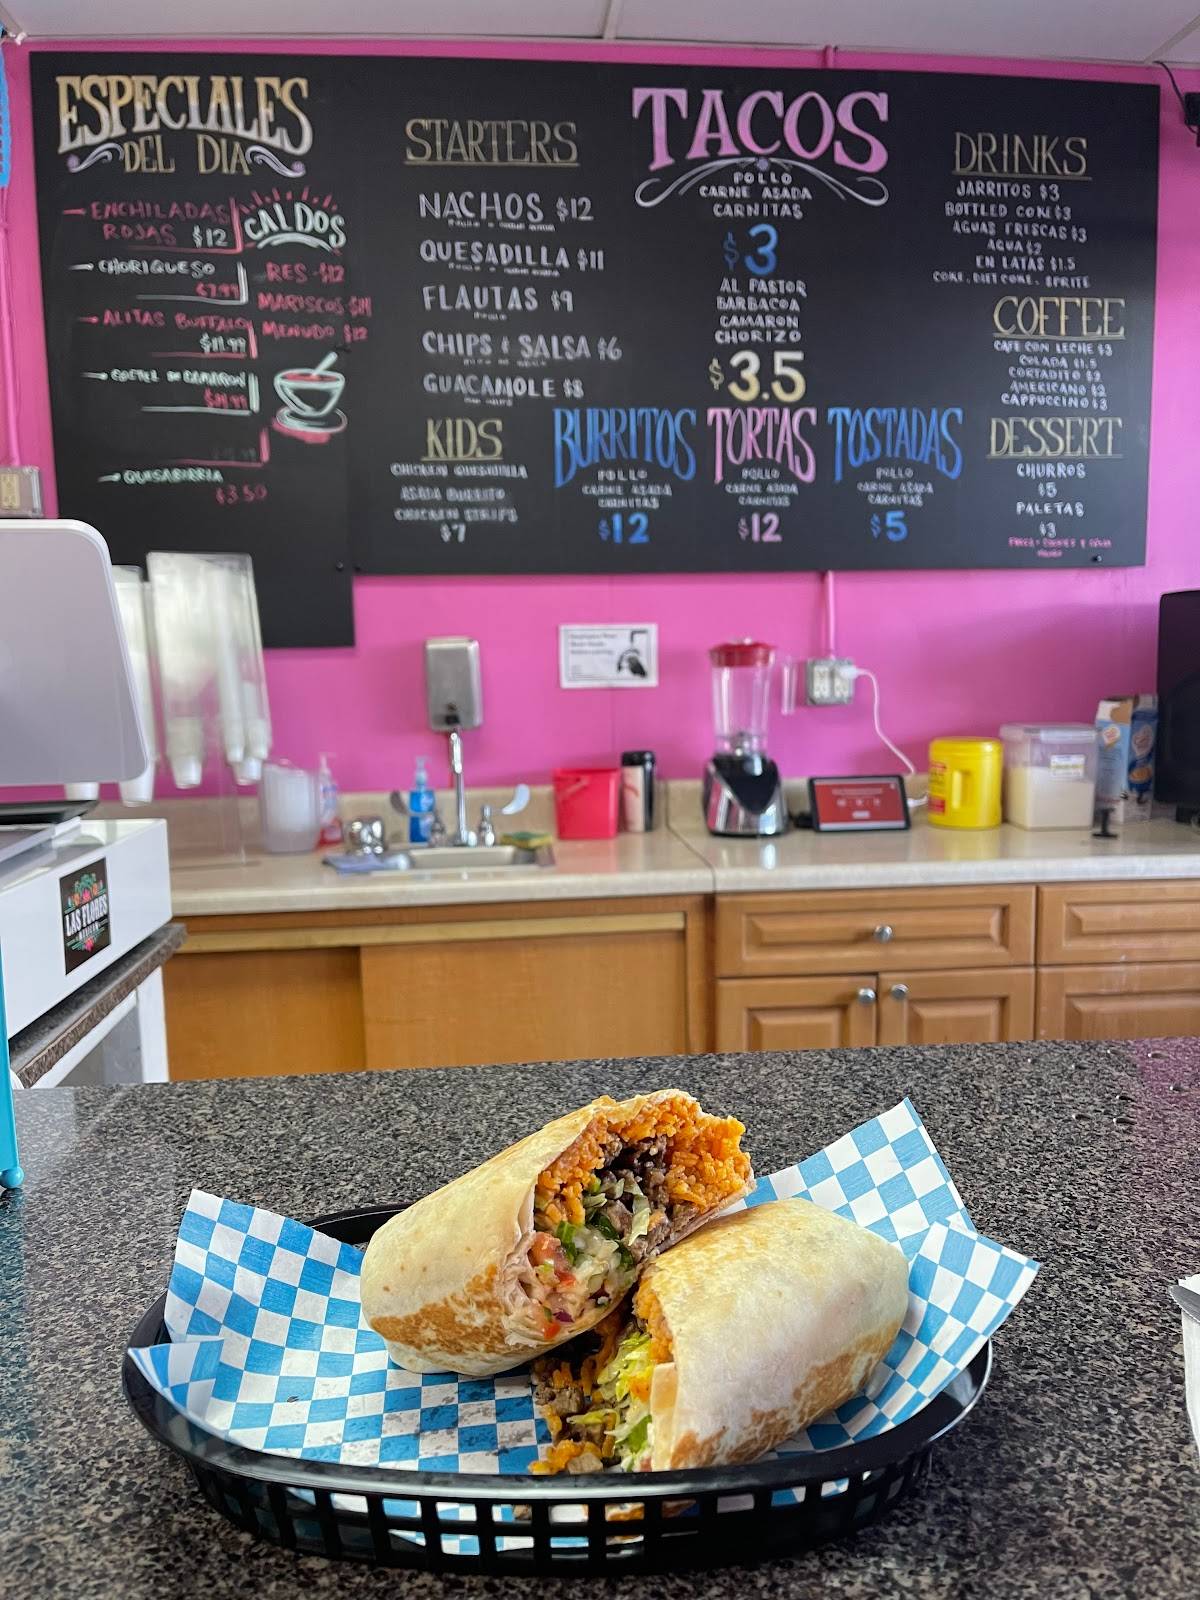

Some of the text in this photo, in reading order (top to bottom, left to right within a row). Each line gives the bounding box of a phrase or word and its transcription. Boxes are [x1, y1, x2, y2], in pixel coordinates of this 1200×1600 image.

[56, 75, 313, 155] ESPECIALES
[404, 118, 579, 164] STARTERS
[632, 87, 890, 174] TACOS
[123, 134, 251, 175] DEL DIA
[954, 131, 1089, 178] DRINKS
[733, 171, 793, 185] POLLO
[699, 185, 813, 201] CARNE ASADA
[956, 180, 1061, 202] JARRITOS $3
[91, 201, 230, 224] ENCHILADAS
[418, 191, 594, 222] NACHOS $12
[713, 203, 804, 220] CARNITAS
[944, 200, 1008, 217] BOTTLED
[1054, 204, 1073, 222] $3
[102, 223, 228, 248] ROJAS $12
[244, 202, 347, 248] CALDOS
[952, 219, 997, 236] AGUAS
[1071, 225, 1088, 244] $3
[419, 239, 570, 269] QUESADILLA
[577, 248, 605, 271] $11
[722, 223, 779, 276] $3
[986, 237, 1024, 252] AGUA
[98, 257, 216, 279] CHORIQUESO
[266, 261, 307, 283] RES
[975, 254, 1077, 273] EN LATAS $1.5
[422, 284, 574, 312] FLAUTAS $9
[719, 277, 807, 298] AL PASTOR
[257, 291, 344, 315] MARISCOS
[716, 296, 800, 312] BARBACOA
[103, 309, 165, 327] ALITAS
[719, 314, 799, 329] CAMARON
[992, 295, 1126, 338] COFFEE
[262, 320, 335, 340] MENUDO
[714, 329, 802, 345] CHORIZO
[421, 330, 493, 357] CHIPS
[518, 334, 592, 361] SALSA
[597, 336, 623, 361] $6
[1023, 340, 1050, 353] CON
[1055, 342, 1095, 355] LECHE
[1018, 354, 1069, 369] COLADA
[708, 349, 807, 403] $3.5
[1008, 366, 1082, 381] CORTADITO
[422, 372, 585, 399] GUACAMOLE $8
[1009, 380, 1088, 397] AMERICANO
[1000, 392, 1090, 409] CAPPUCCINO
[426, 416, 504, 460] KIDS
[553, 407, 698, 489] BURRITOS
[706, 407, 818, 484] TORTAS
[827, 407, 964, 484] TOSTADAS
[990, 416, 1123, 458] DESSERT
[597, 469, 648, 482] POLLO
[741, 467, 781, 480] POLLO
[875, 466, 914, 479] POLLO
[1016, 462, 1087, 479] CHURROS
[1037, 481, 1058, 498] $5
[1015, 501, 1085, 517] PALETAS
[439, 523, 467, 543] $7
[598, 512, 650, 545] $12
[737, 512, 783, 543] $12
[869, 510, 909, 542] $5
[1039, 521, 1057, 539] $3
[65, 909, 82, 937] LAS
